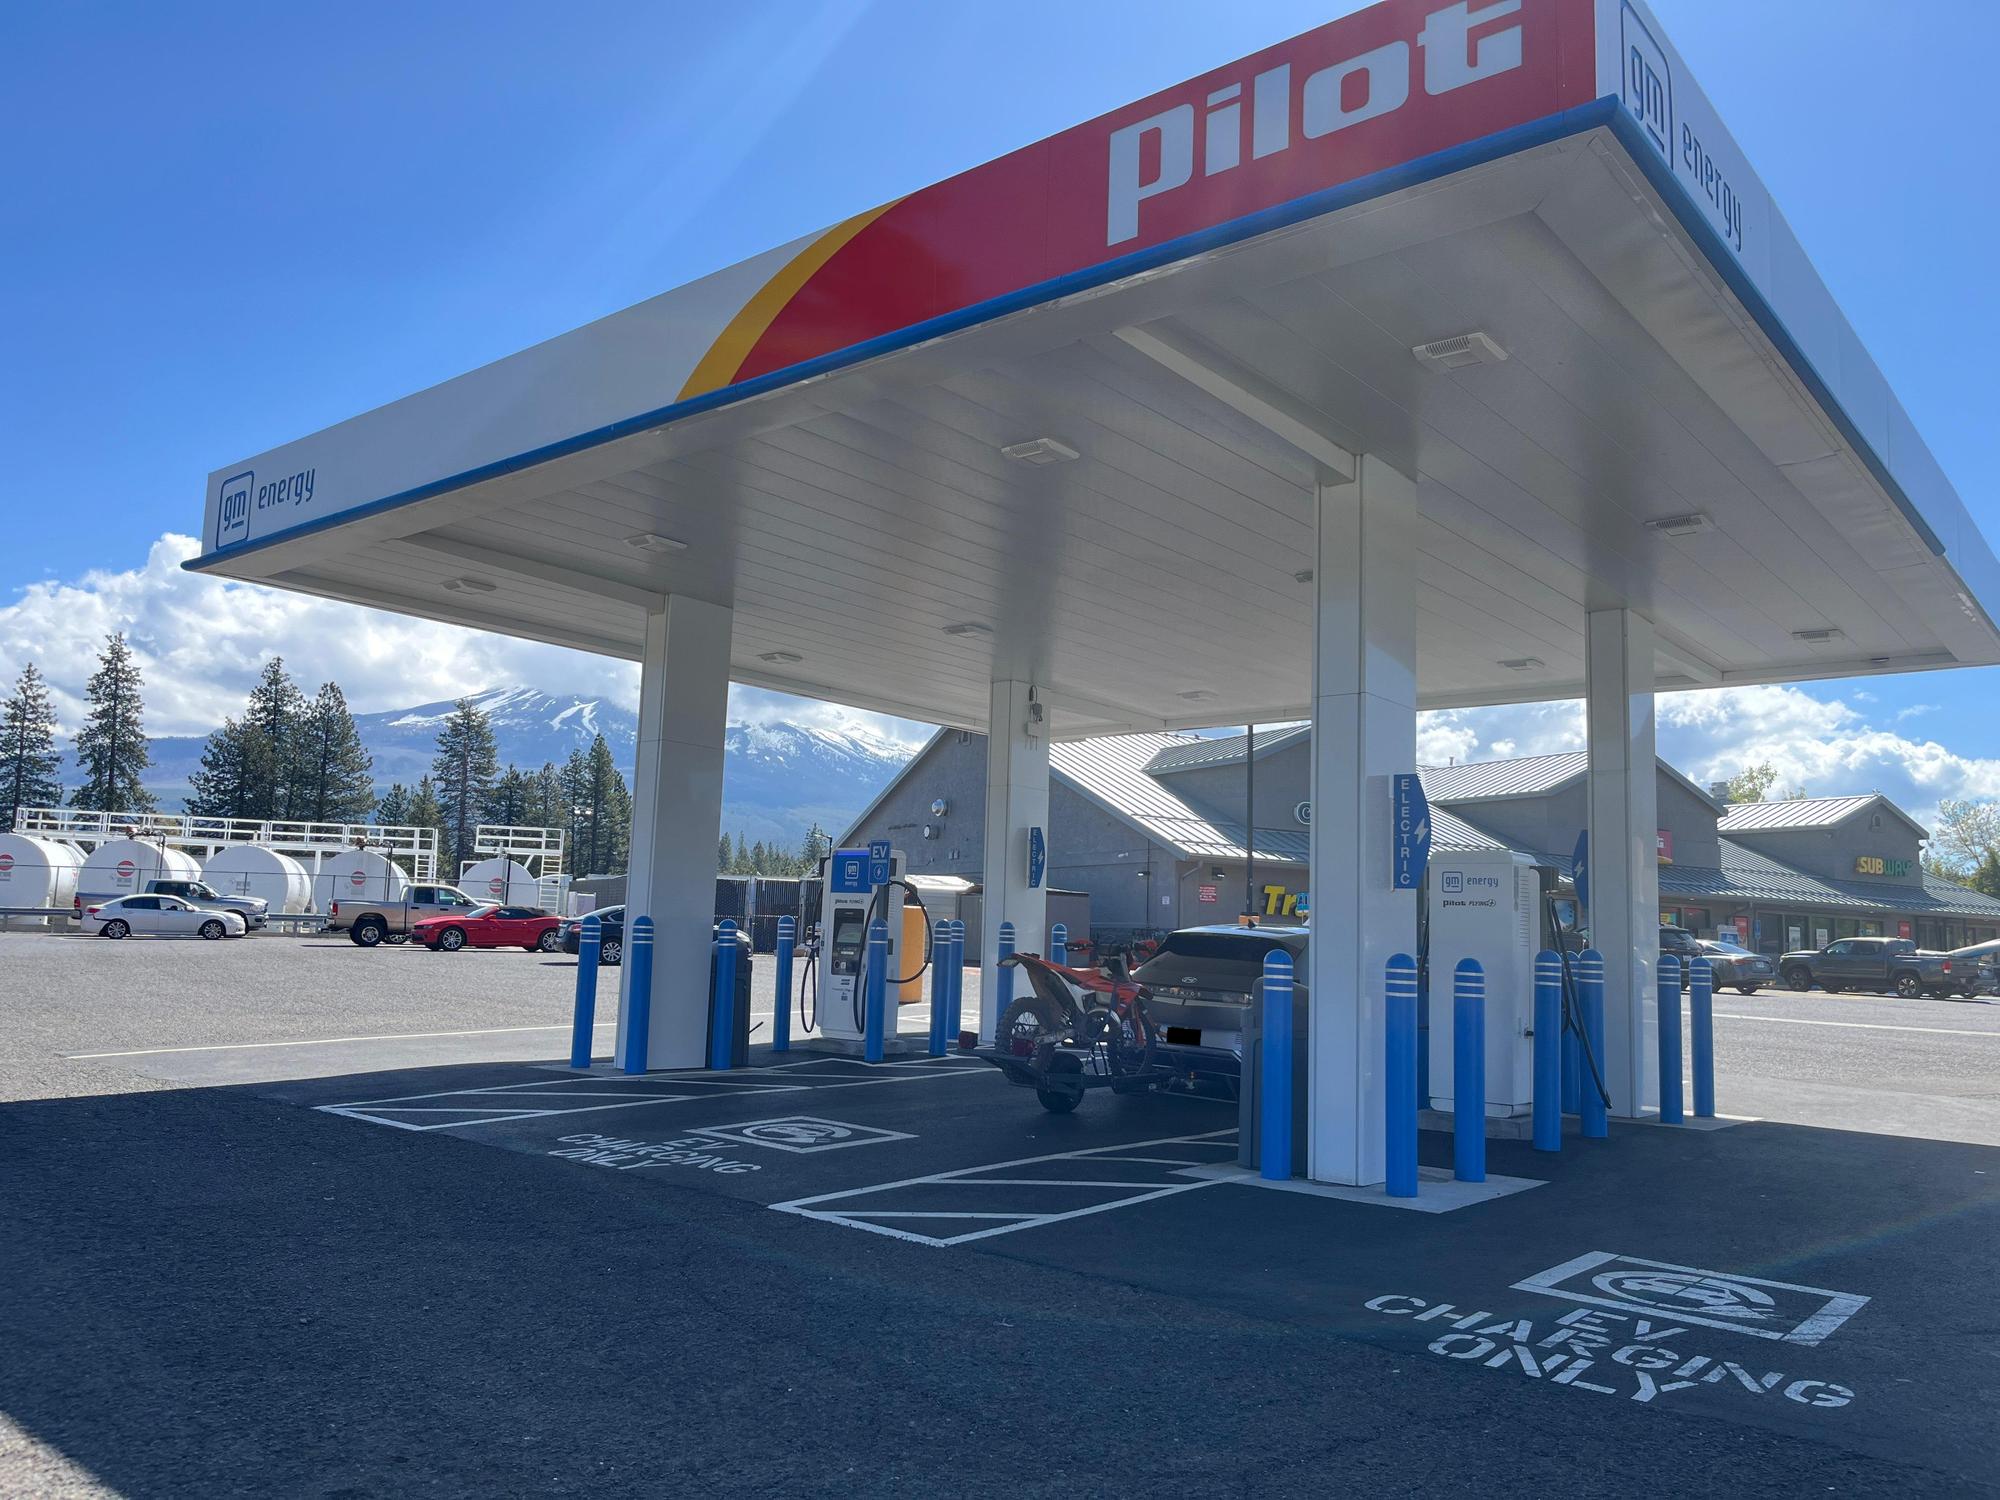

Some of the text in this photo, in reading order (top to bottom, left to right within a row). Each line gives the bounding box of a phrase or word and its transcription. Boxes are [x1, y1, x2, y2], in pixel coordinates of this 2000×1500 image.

[1107, 0, 1523, 247] pilot
[1630, 44, 1742, 253] gm energy
[223, 467, 316, 532] gm energy
[872, 845, 888, 859] EV
[1400, 778, 1411, 885] ELECTRIC
[1445, 876, 1499, 888] gm energy
[1856, 856, 1912, 876] SUBWAY
[547, 1147, 671, 1170] ONLY
[556, 1133, 762, 1174] CHARGING
[662, 1137, 740, 1150] EV
[1554, 1307, 1689, 1342] EV
[1364, 1294, 1856, 1408] CHARGING
[1427, 1333, 1699, 1402] ONLY
